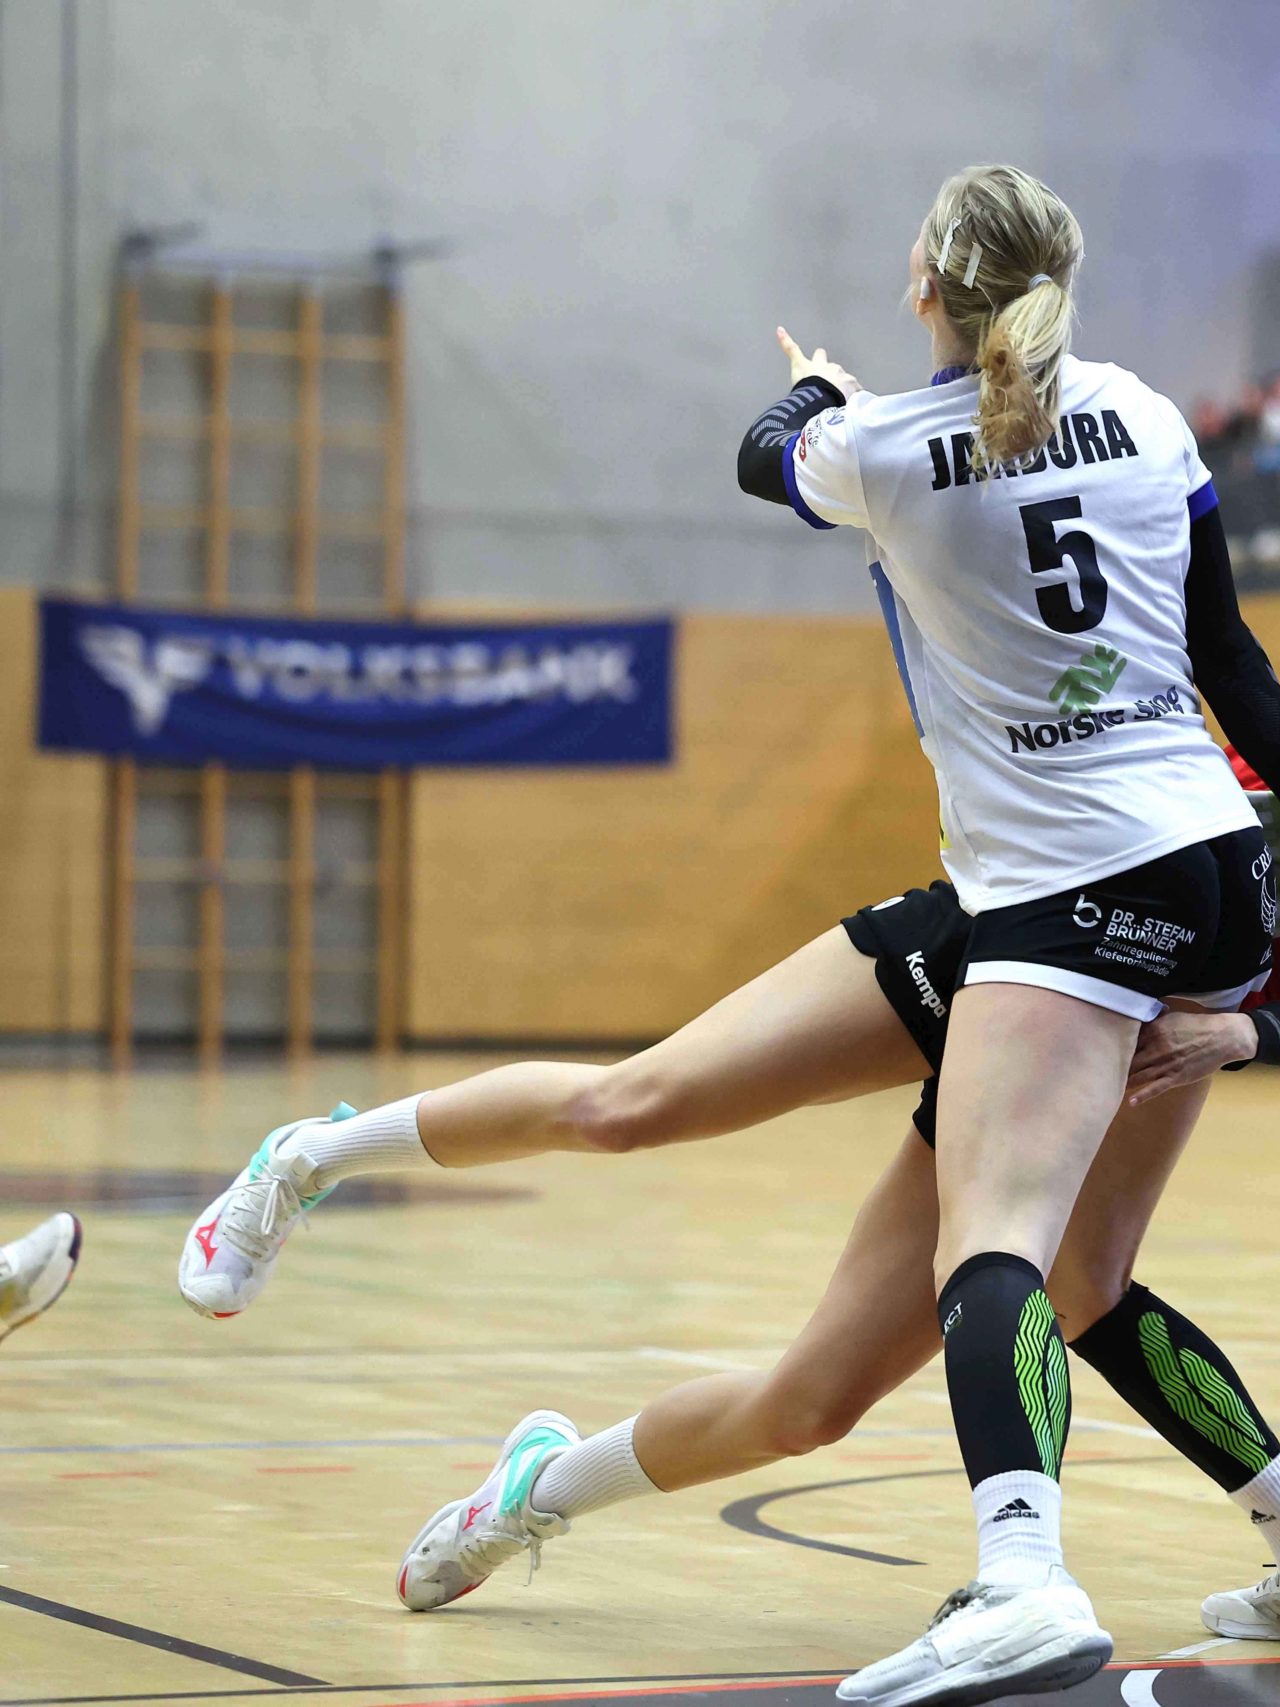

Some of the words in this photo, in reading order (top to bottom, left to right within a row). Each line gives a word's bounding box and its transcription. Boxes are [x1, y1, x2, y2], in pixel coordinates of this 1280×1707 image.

[1019, 495, 1109, 635] 5
[1142, 917, 1196, 944] STEFAN
[905, 950, 947, 1018] Kempa
[992, 1508, 1040, 1522] adidas
